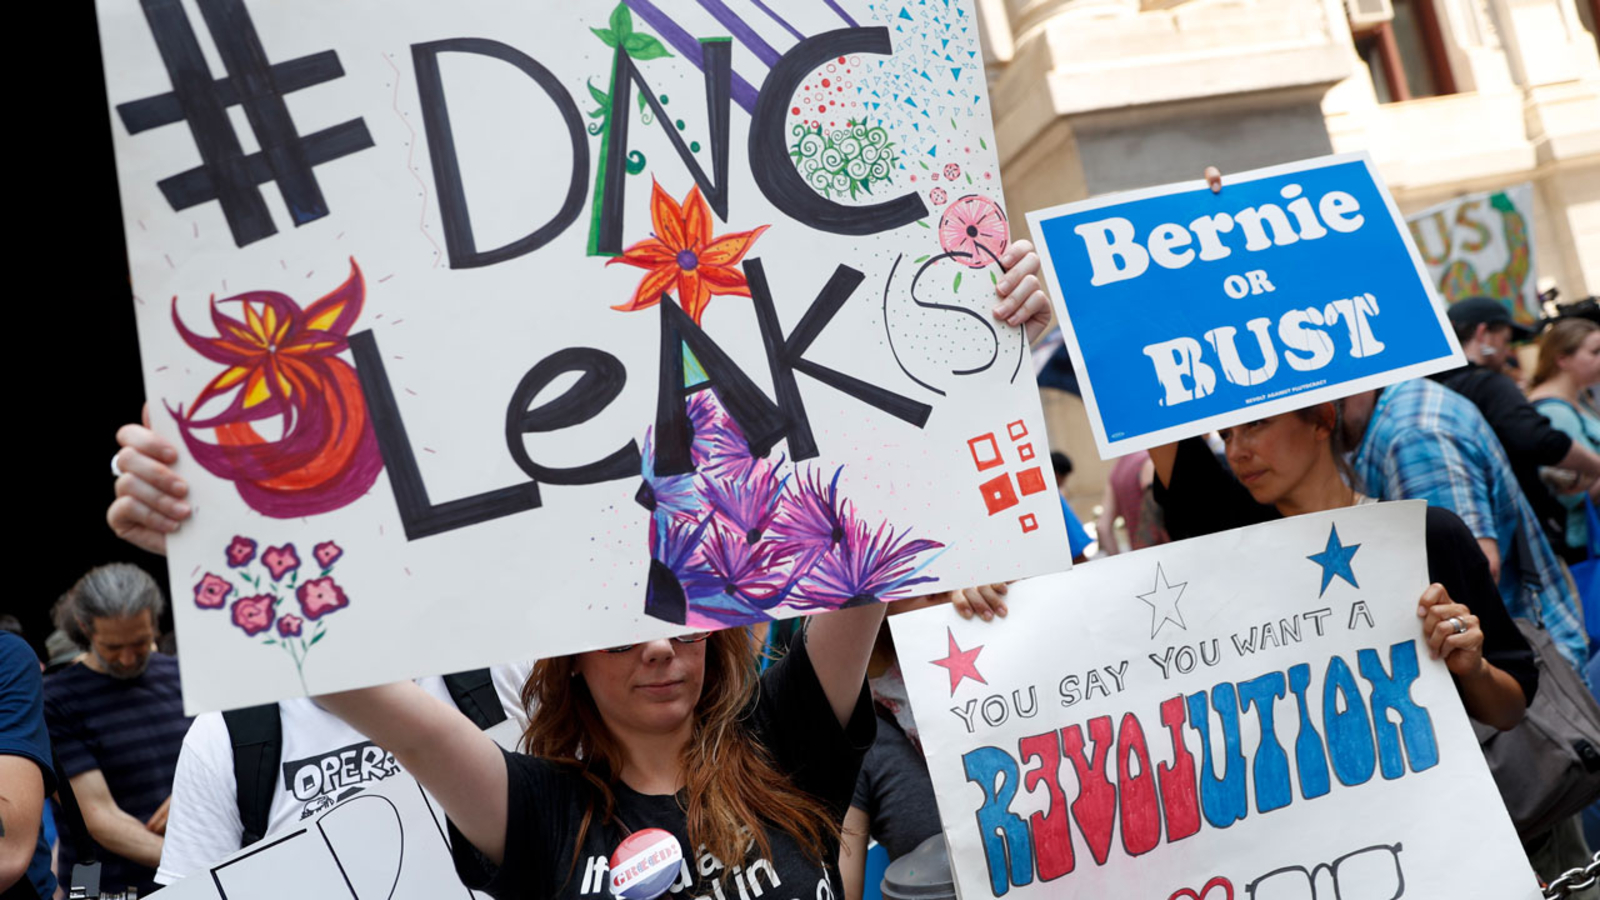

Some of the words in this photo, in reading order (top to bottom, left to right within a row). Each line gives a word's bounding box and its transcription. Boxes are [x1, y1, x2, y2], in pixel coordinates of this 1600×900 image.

[116, 0, 930, 270] #DNC
[1074, 183, 1365, 287] Bernie
[1223, 269, 1276, 299] OR
[1142, 292, 1386, 407] BUST
[951, 686, 1039, 733] YOU
[1059, 660, 1129, 708] SAY
[1149, 638, 1221, 681] YOU
[1231, 607, 1332, 657] WANT
[1348, 600, 1376, 630] A
